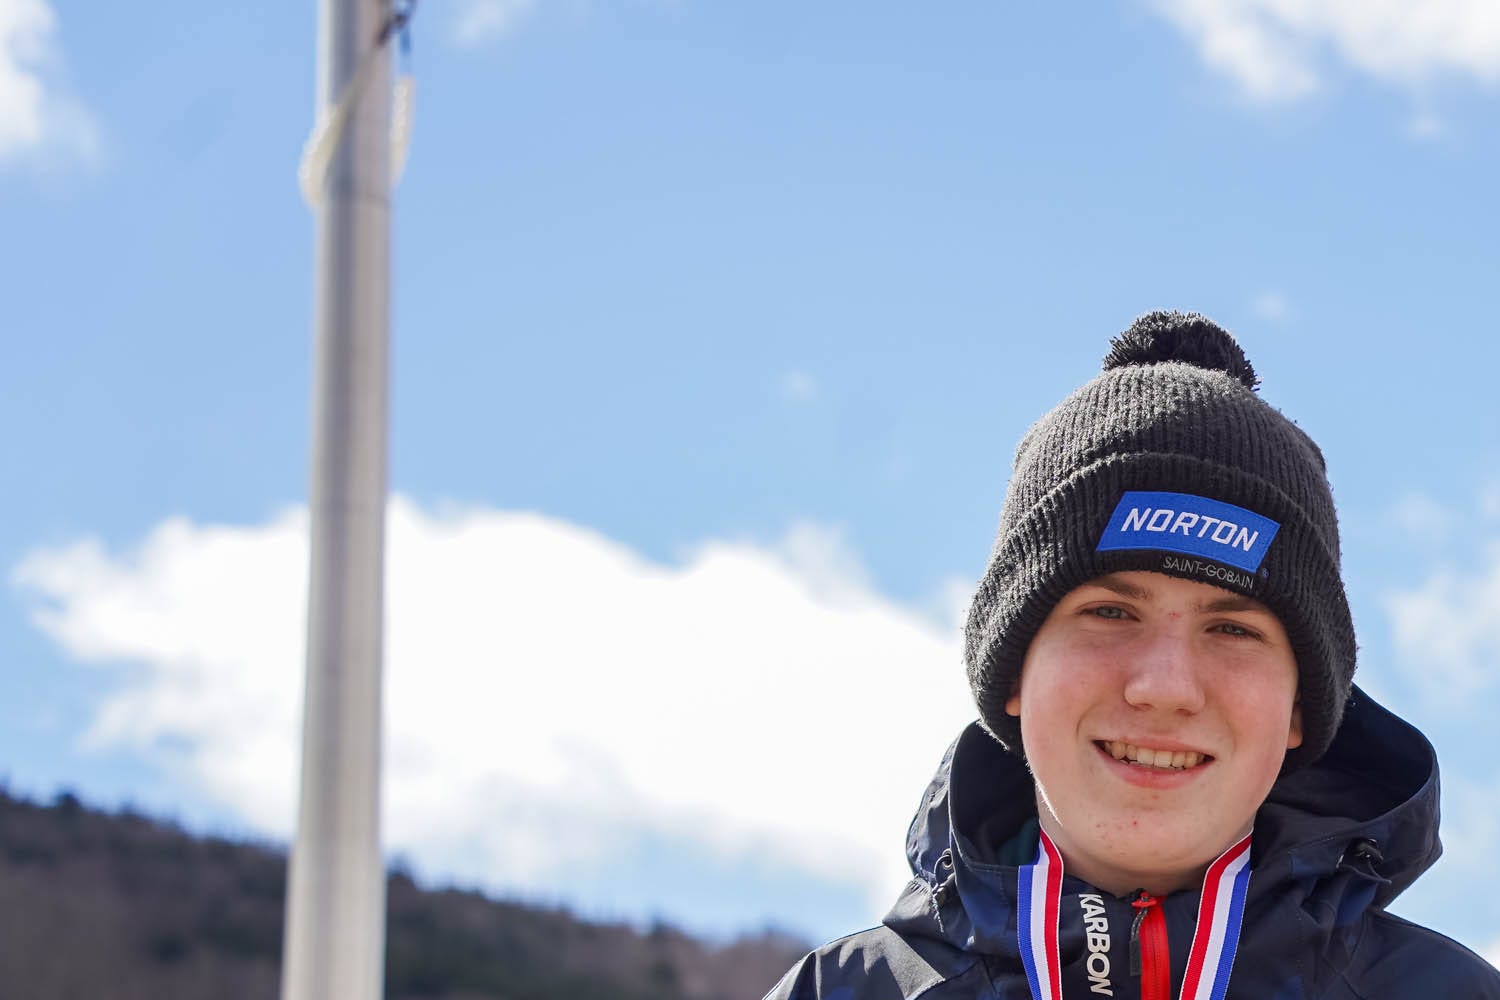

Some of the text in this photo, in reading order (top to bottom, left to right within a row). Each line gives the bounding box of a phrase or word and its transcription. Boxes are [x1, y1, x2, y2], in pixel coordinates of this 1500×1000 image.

[1121, 507, 1259, 552] NORTON
[1162, 556, 1254, 590] SAINT-GOBAIN
[1078, 893, 1114, 997] KARBON
